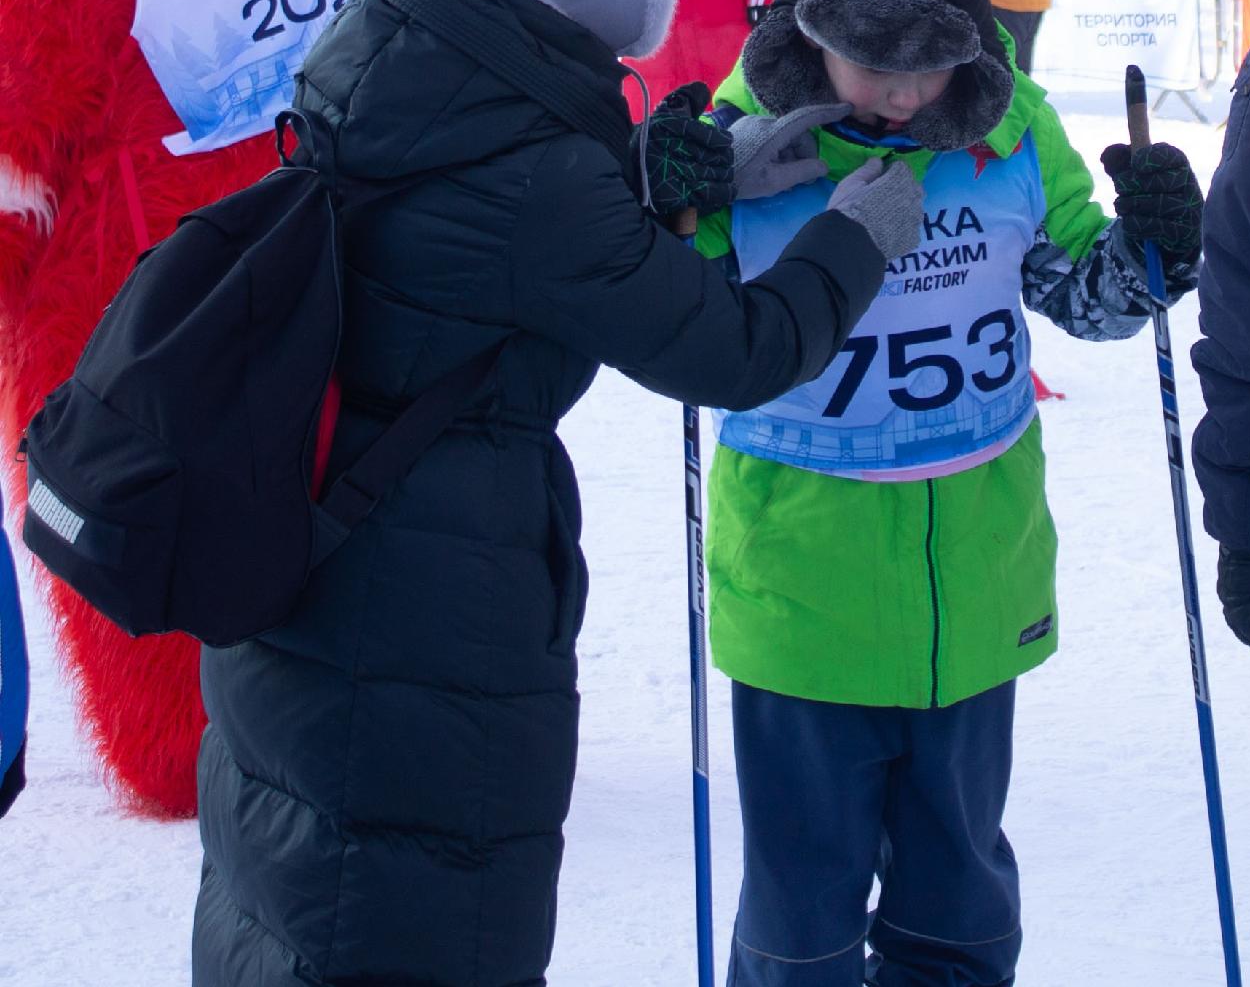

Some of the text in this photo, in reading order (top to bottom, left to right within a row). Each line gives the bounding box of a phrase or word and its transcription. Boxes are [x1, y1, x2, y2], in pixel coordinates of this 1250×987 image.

[1074, 13, 1177, 29] ТЕРРИТОРИЯ
[1096, 32, 1158, 47] СПОРТА
[923, 206, 985, 241] КА
[885, 242, 988, 270] АЛХИМ
[820, 308, 1017, 418] 753
